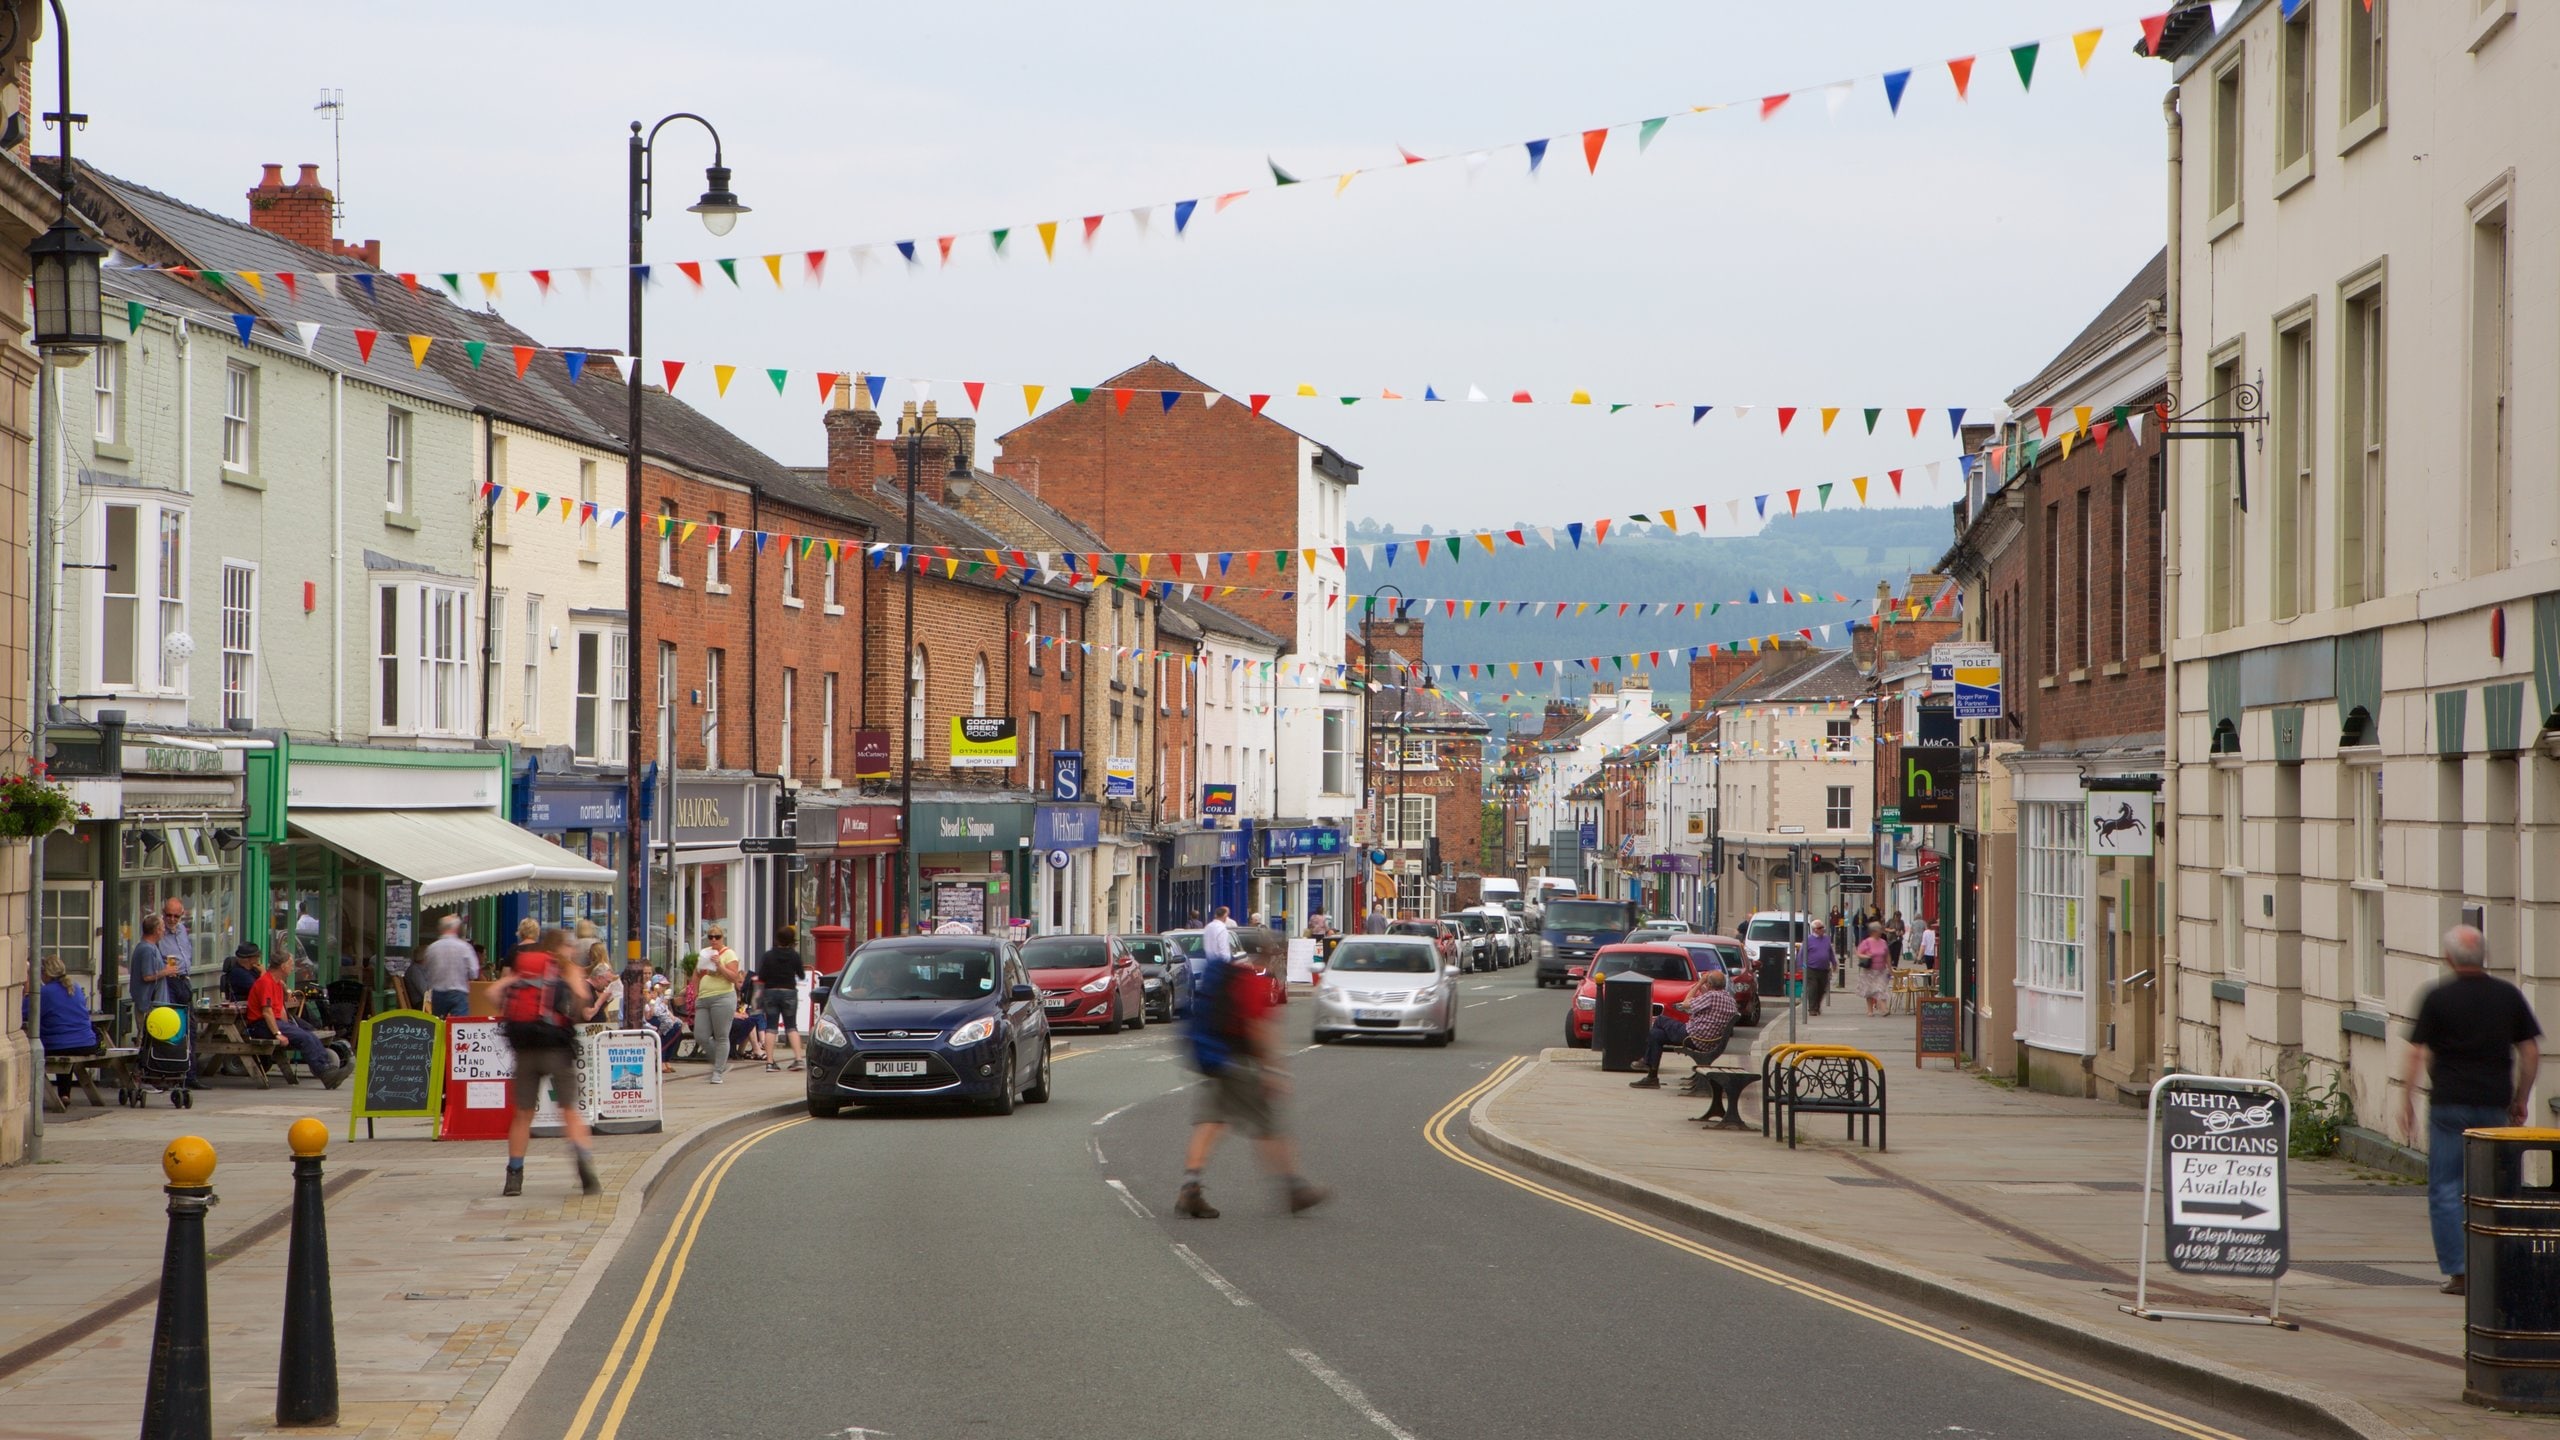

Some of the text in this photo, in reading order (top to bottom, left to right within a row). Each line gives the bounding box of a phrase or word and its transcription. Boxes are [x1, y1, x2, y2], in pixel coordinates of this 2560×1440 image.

[1422, 776, 1455, 787] OAK
[580, 799, 621, 823] norman lloyd
[677, 797, 719, 828] MAJORS
[940, 816, 994, 843] Stead & Simpson
[1052, 812, 1084, 842] WHSmith
[378, 1024, 428, 1036] Lovedays
[457, 1028, 487, 1040] SUE'S
[383, 1042, 424, 1050] ANTIQUES
[472, 1041, 493, 1052] 2ND
[608, 1048, 646, 1056] Market
[458, 1054, 485, 1065] HAND
[470, 1067, 491, 1078] DEN
[896, 1062, 918, 1073] UEU
[392, 1075, 424, 1083] BROWSE
[613, 1091, 642, 1099] OPEN
[2170, 1092, 2241, 1110] MEHTA
[2170, 1133, 2279, 1154] OPTICIANS
[2183, 1157, 2273, 1178] Eye Tests
[2179, 1177, 2267, 1197] Available
[2173, 1243, 2281, 1264] 01938 552336
